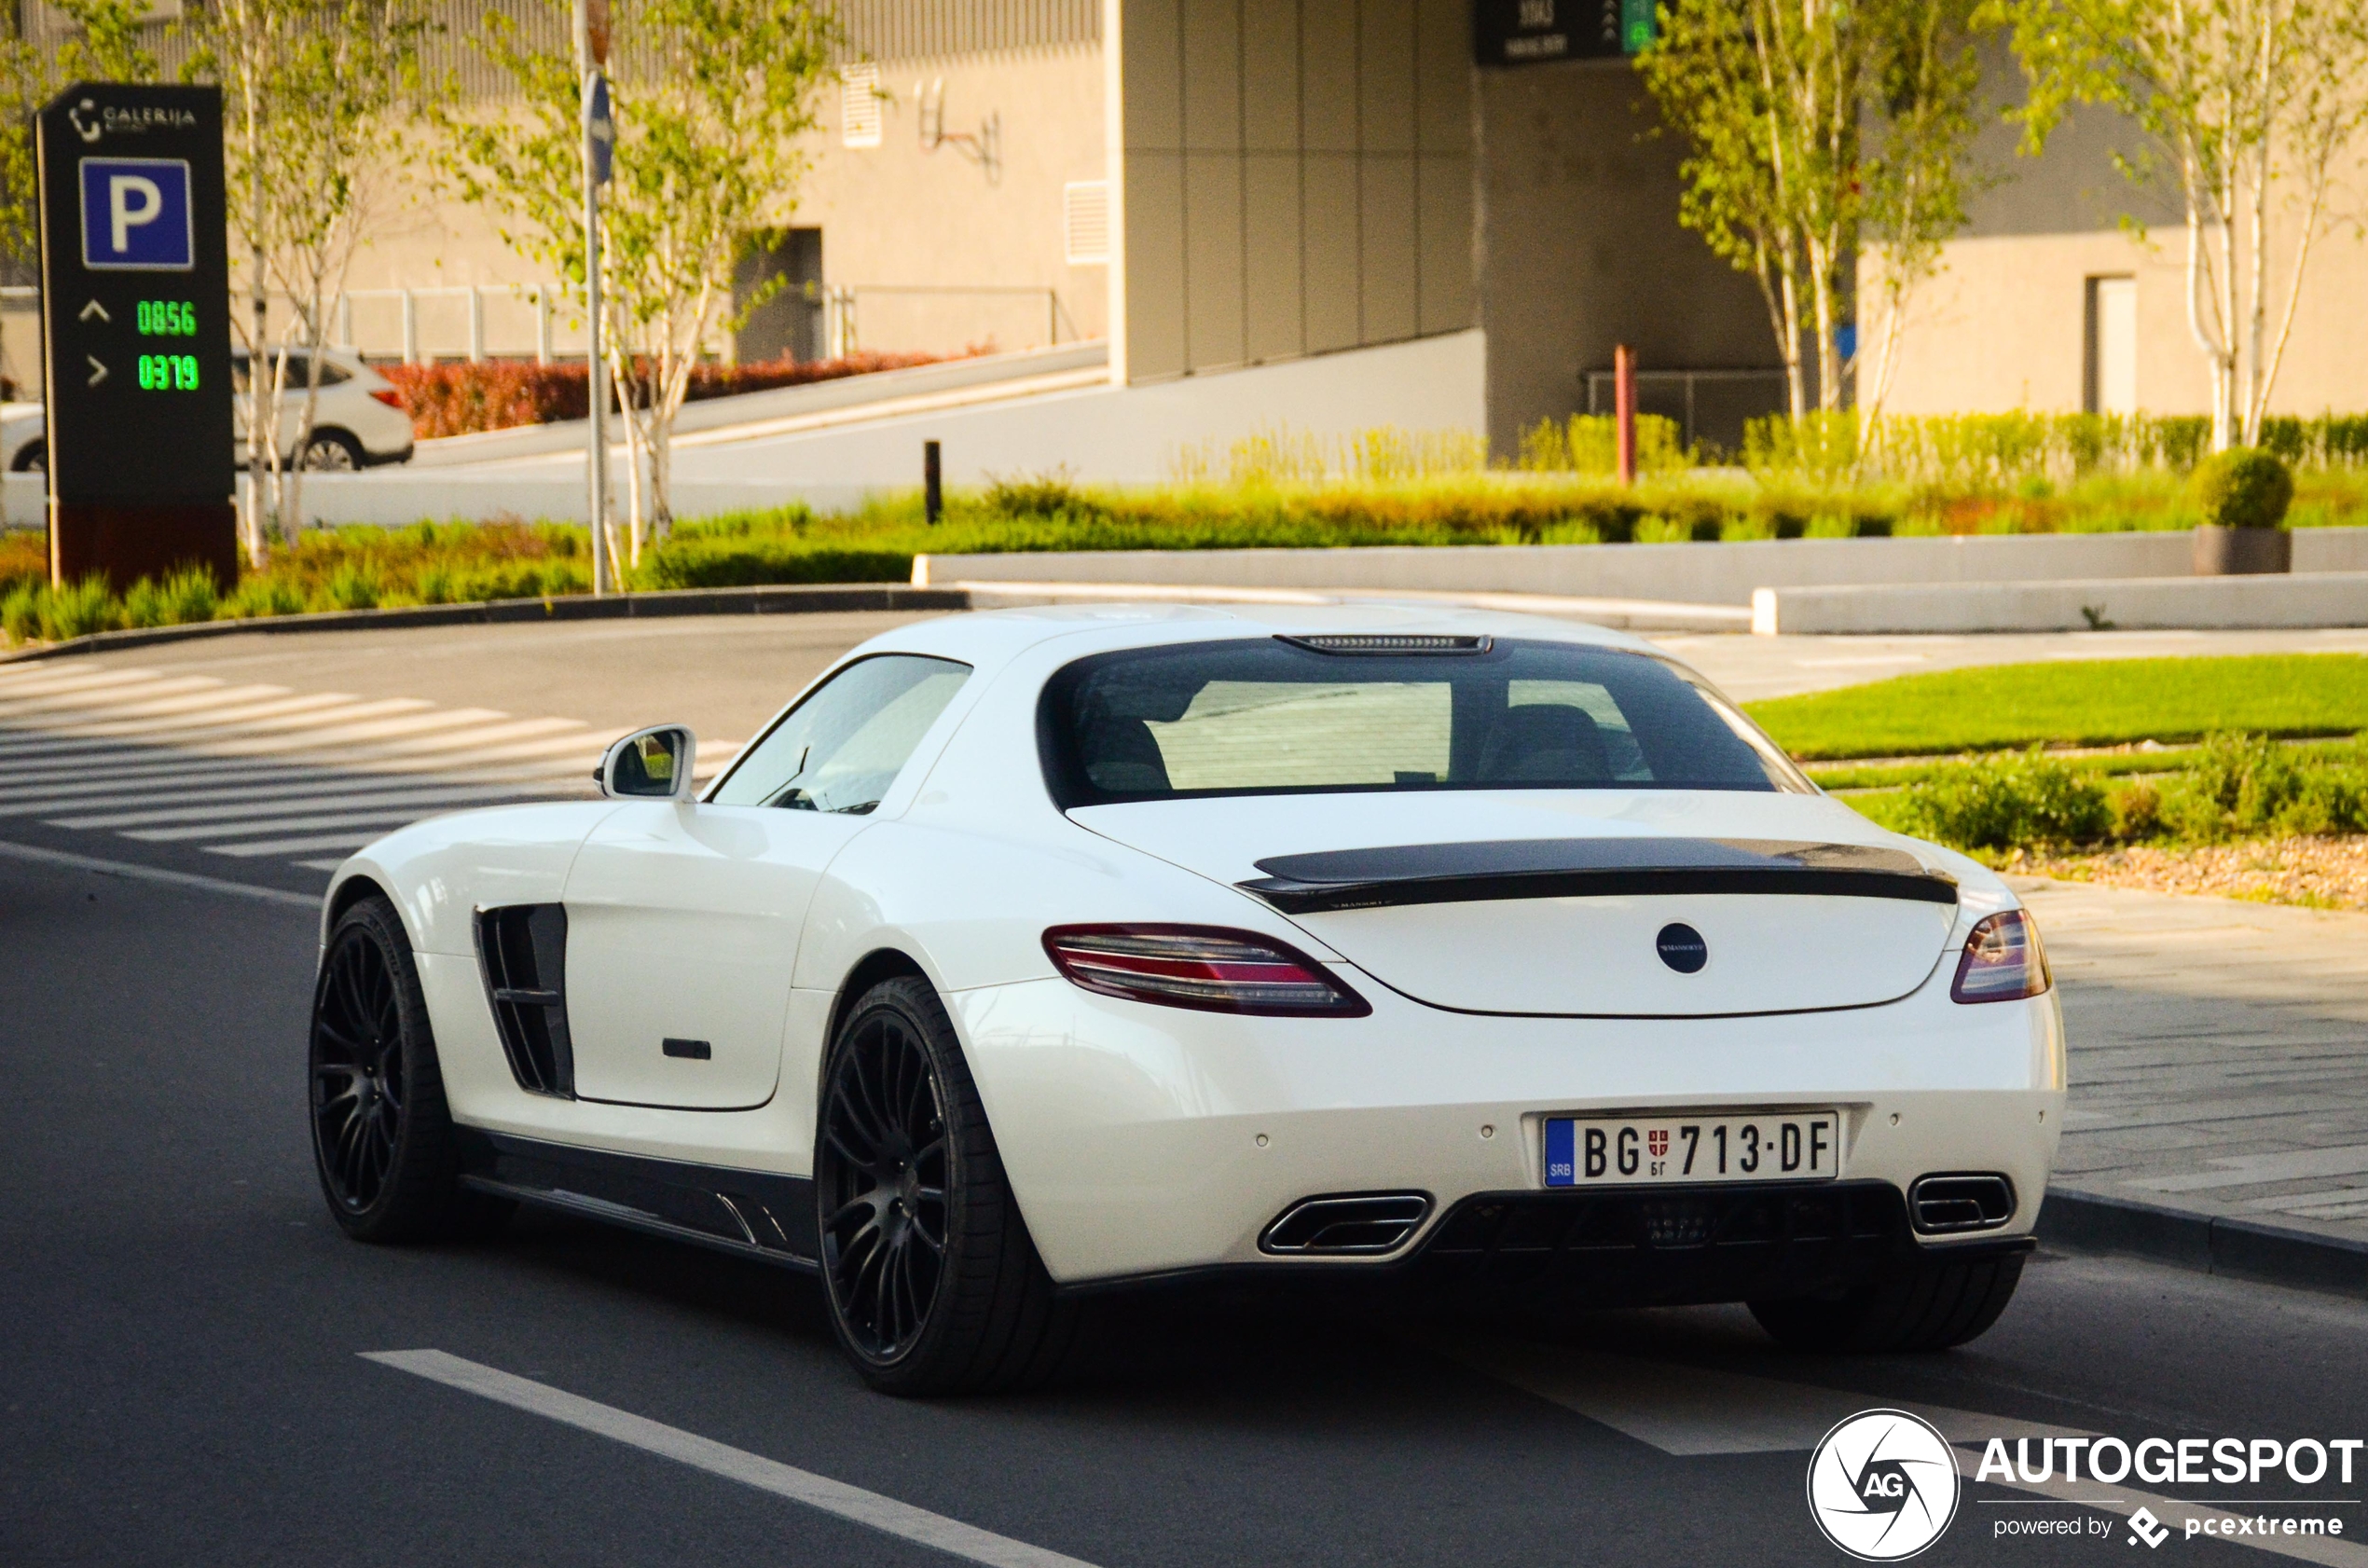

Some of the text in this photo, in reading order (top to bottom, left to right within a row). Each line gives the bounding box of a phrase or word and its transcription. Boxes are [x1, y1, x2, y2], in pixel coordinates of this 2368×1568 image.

[103, 106, 197, 129] GALERIJA
[111, 177, 162, 253] P
[137, 300, 197, 336] 0856
[138, 354, 199, 391] 0379
[1549, 1163, 1572, 1177] SRB
[1584, 1126, 1640, 1178] BG
